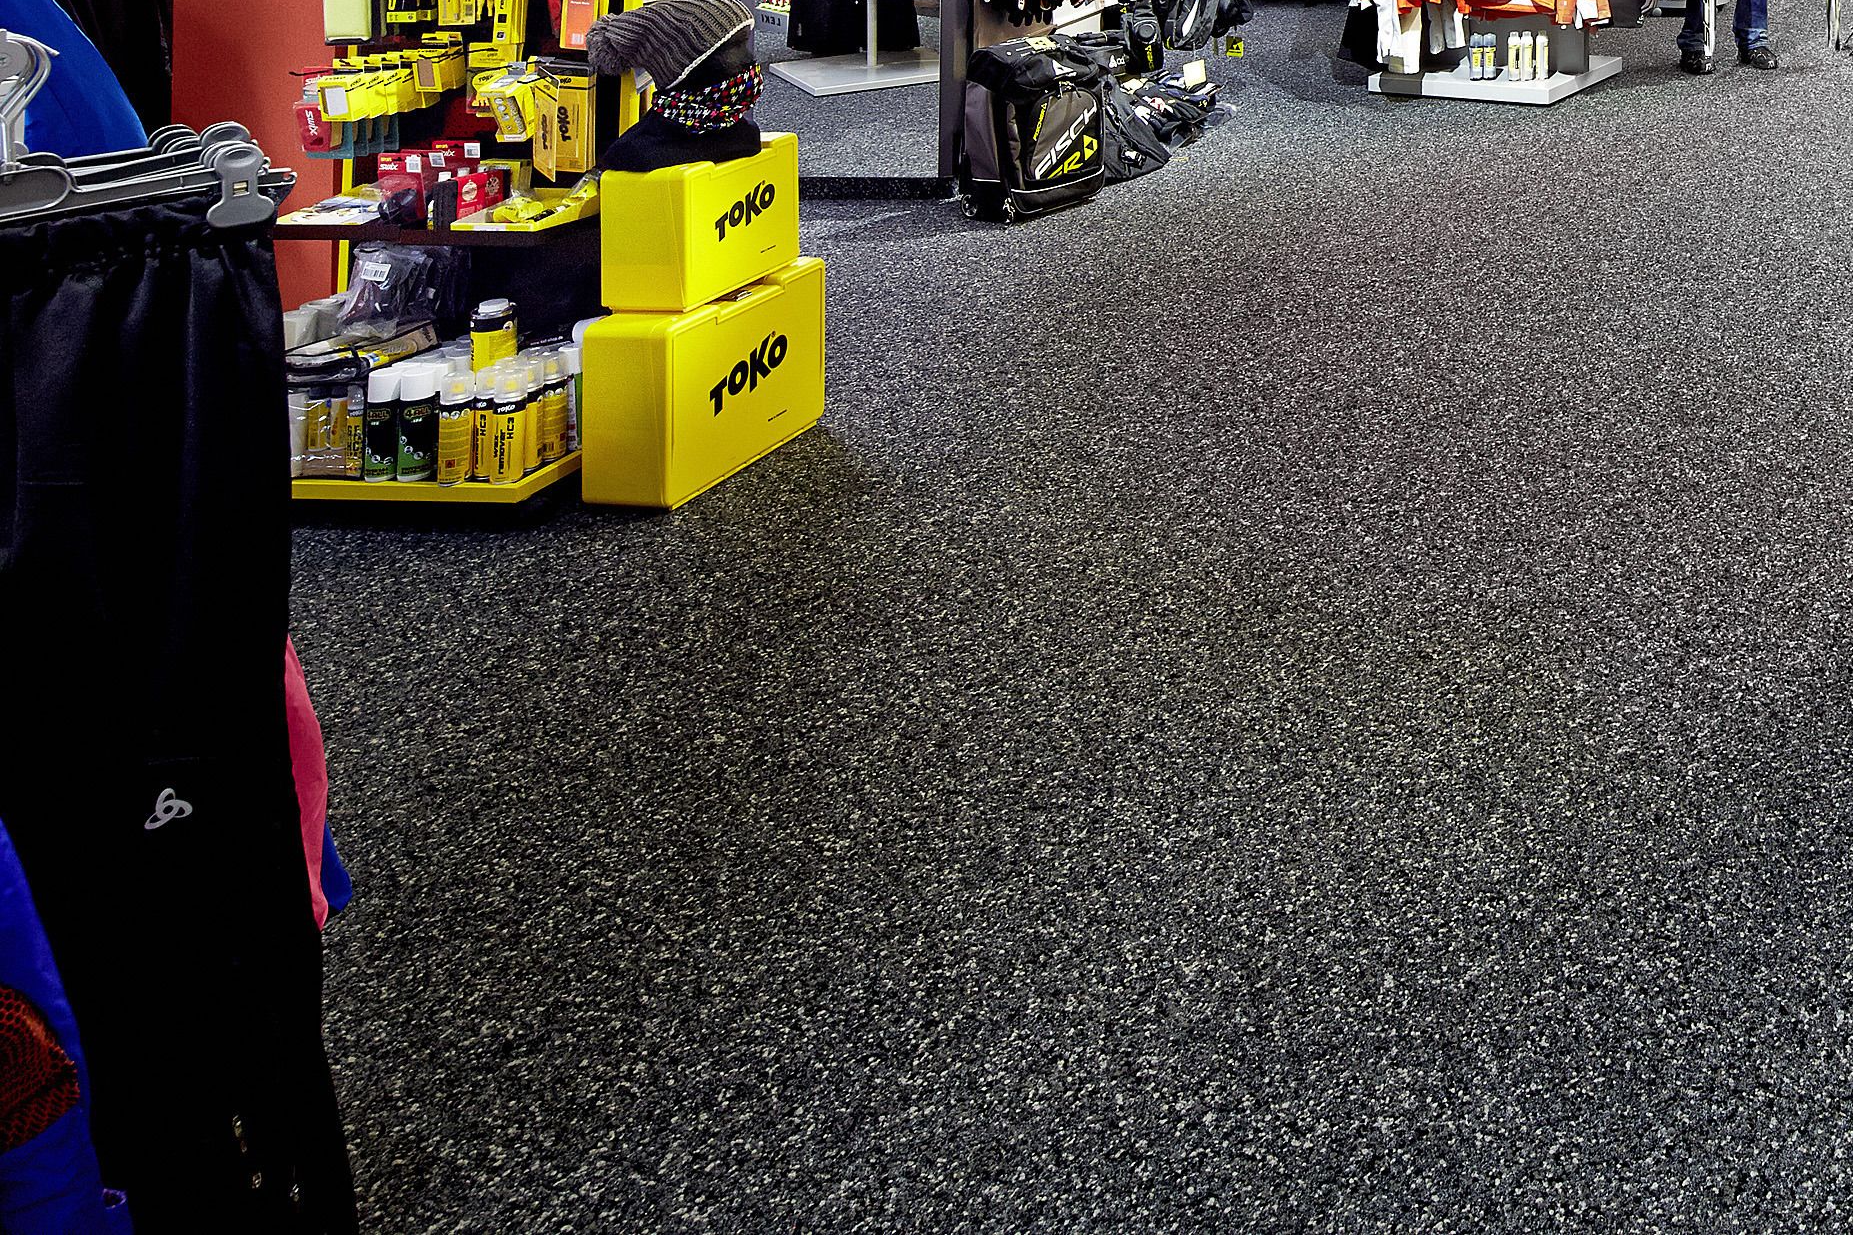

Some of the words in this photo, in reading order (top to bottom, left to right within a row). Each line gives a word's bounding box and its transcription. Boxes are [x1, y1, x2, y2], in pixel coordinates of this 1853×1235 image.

[305, 109, 318, 137] swix
[557, 105, 572, 142] TOKO
[715, 181, 776, 242] TOKO
[709, 331, 788, 417] TOKO
[497, 404, 516, 414] TOKO
[507, 416, 515, 440] HC3
[498, 429, 507, 475] remover
